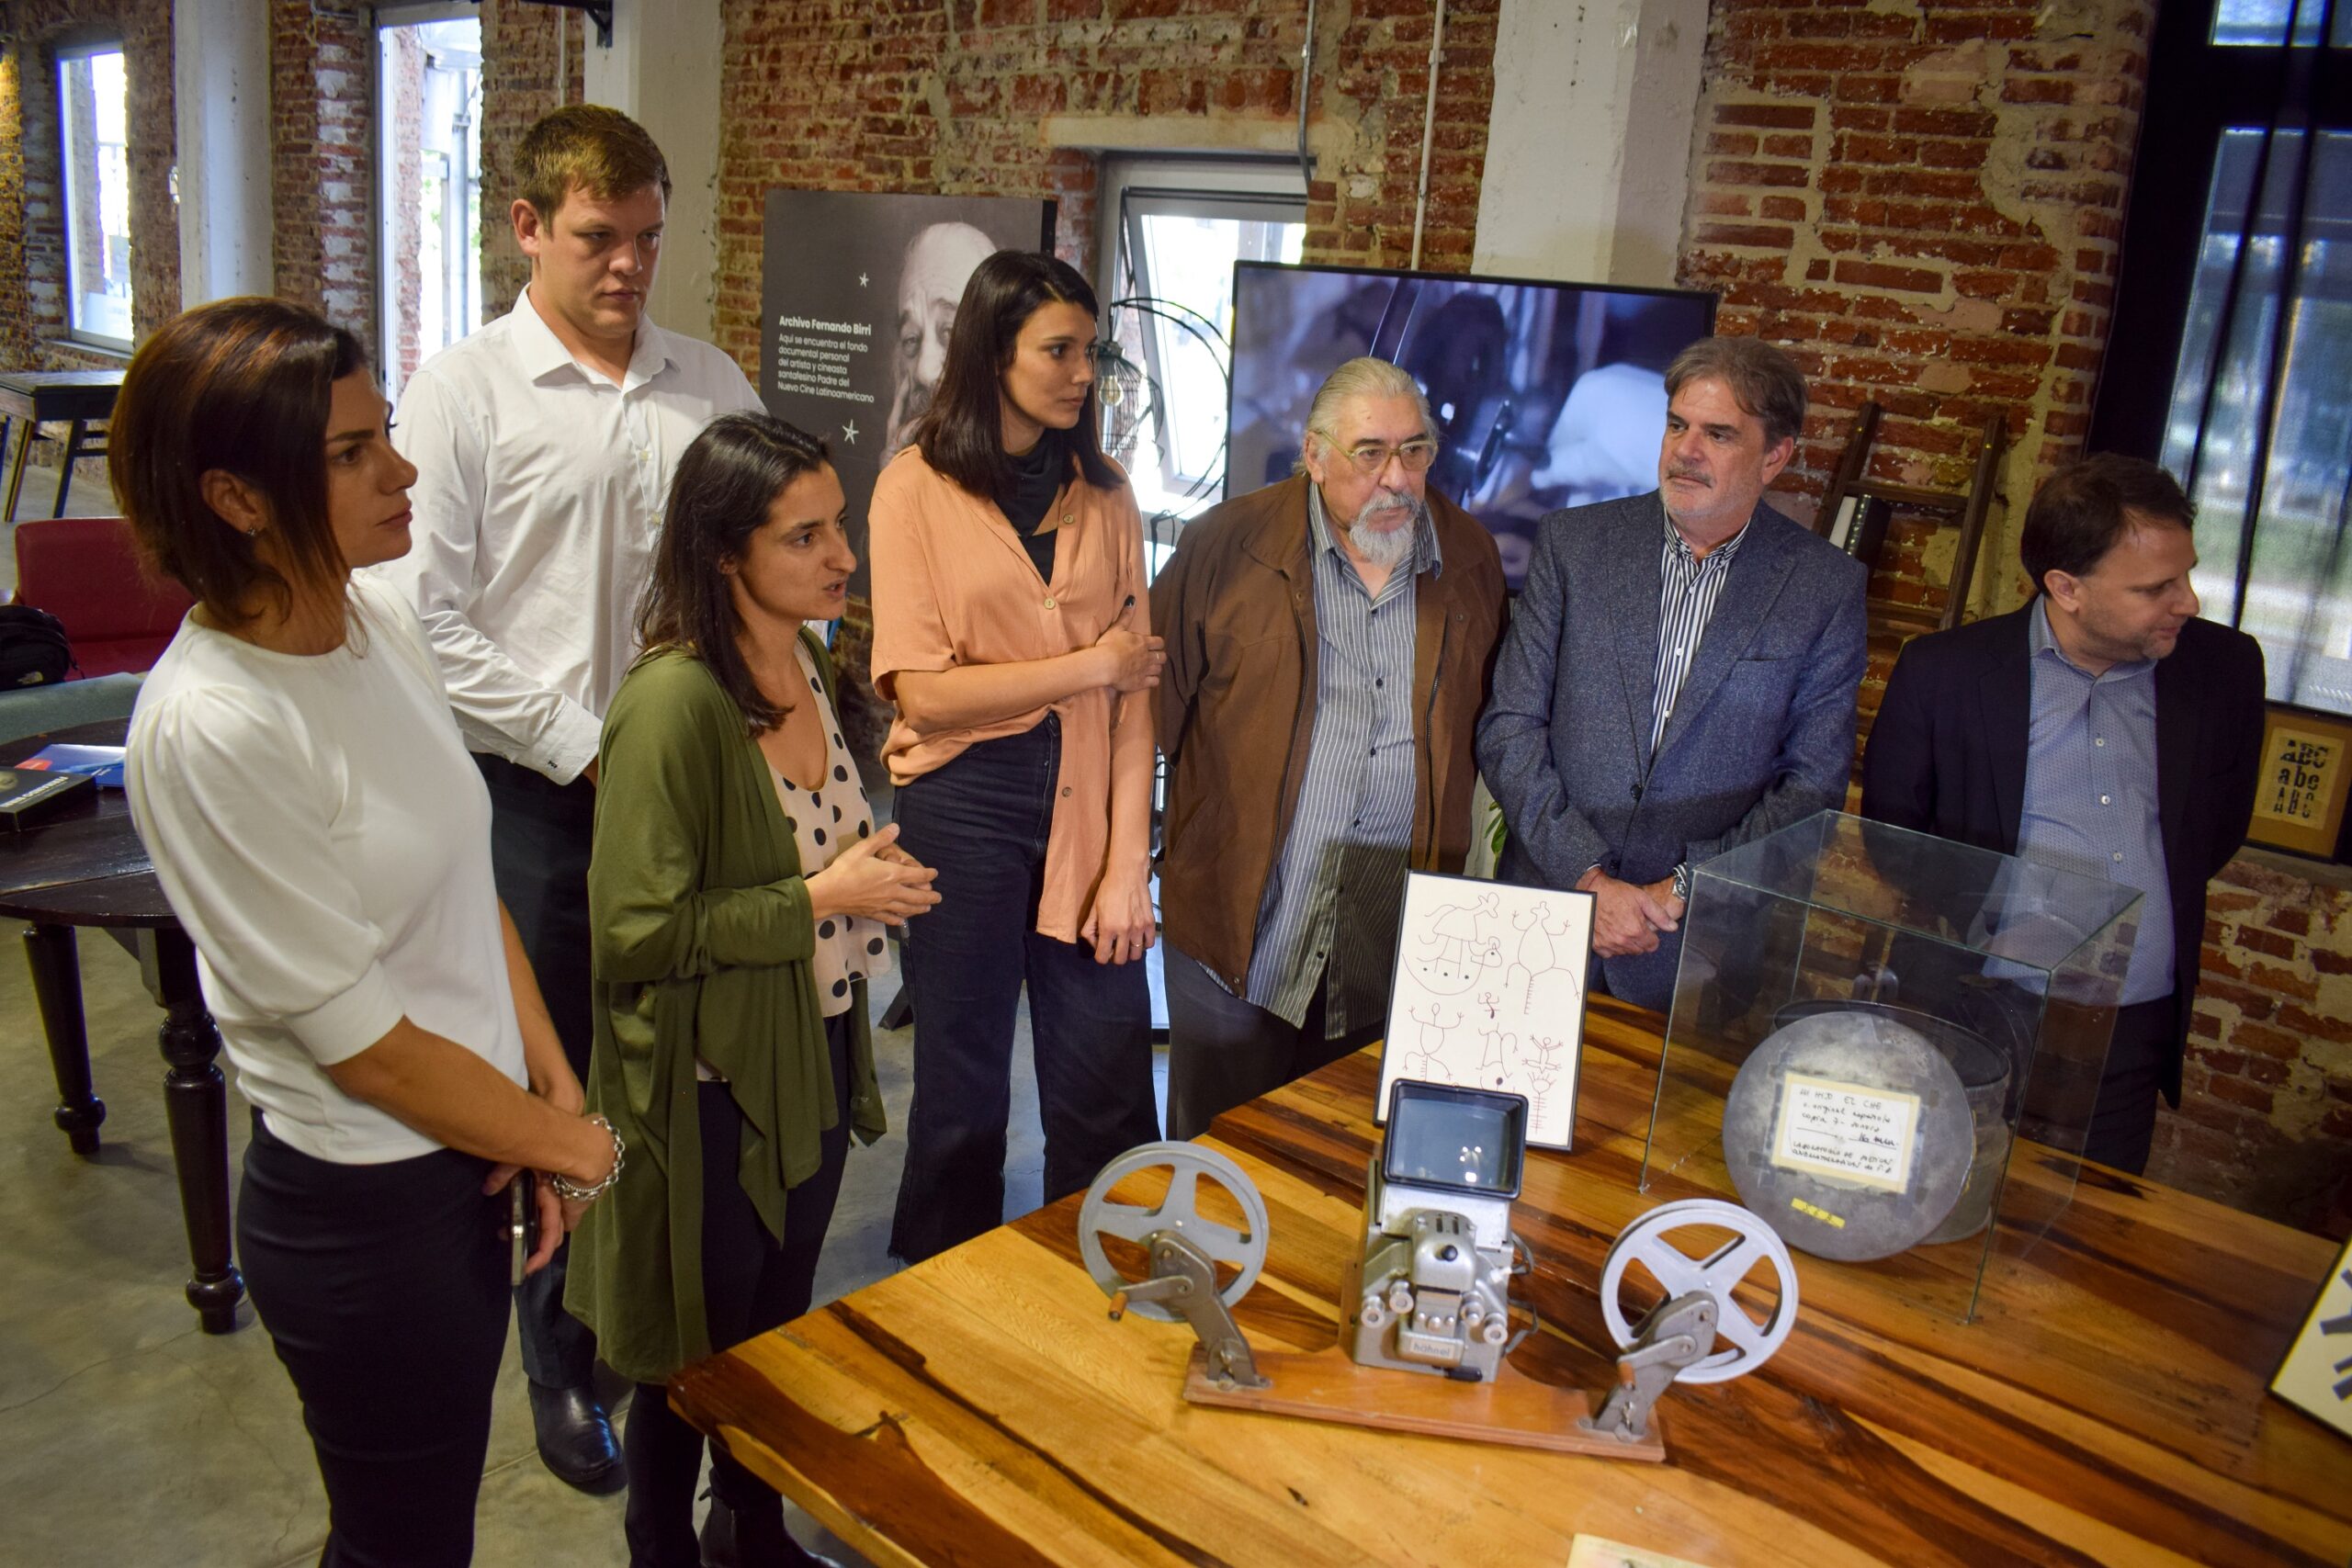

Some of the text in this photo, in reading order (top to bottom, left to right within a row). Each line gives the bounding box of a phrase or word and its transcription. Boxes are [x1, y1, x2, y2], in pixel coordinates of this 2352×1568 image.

[779, 316, 871, 336] Archivo Fernando Birri
[795, 336, 802, 344] se
[804, 337, 838, 349] encuentra
[840, 341, 846, 349] el
[847, 341, 867, 353] fondo
[778, 345, 850, 363] documental personal
[778, 357, 847, 375] del artista y cineasta
[778, 370, 850, 387] santafesino Padre del
[778, 381, 875, 403] Nuevo Cine Latinoamericano
[1813, 1104, 1846, 1114] original
[1844, 1096, 1856, 1106] EL
[1863, 1100, 1882, 1111] CHE
